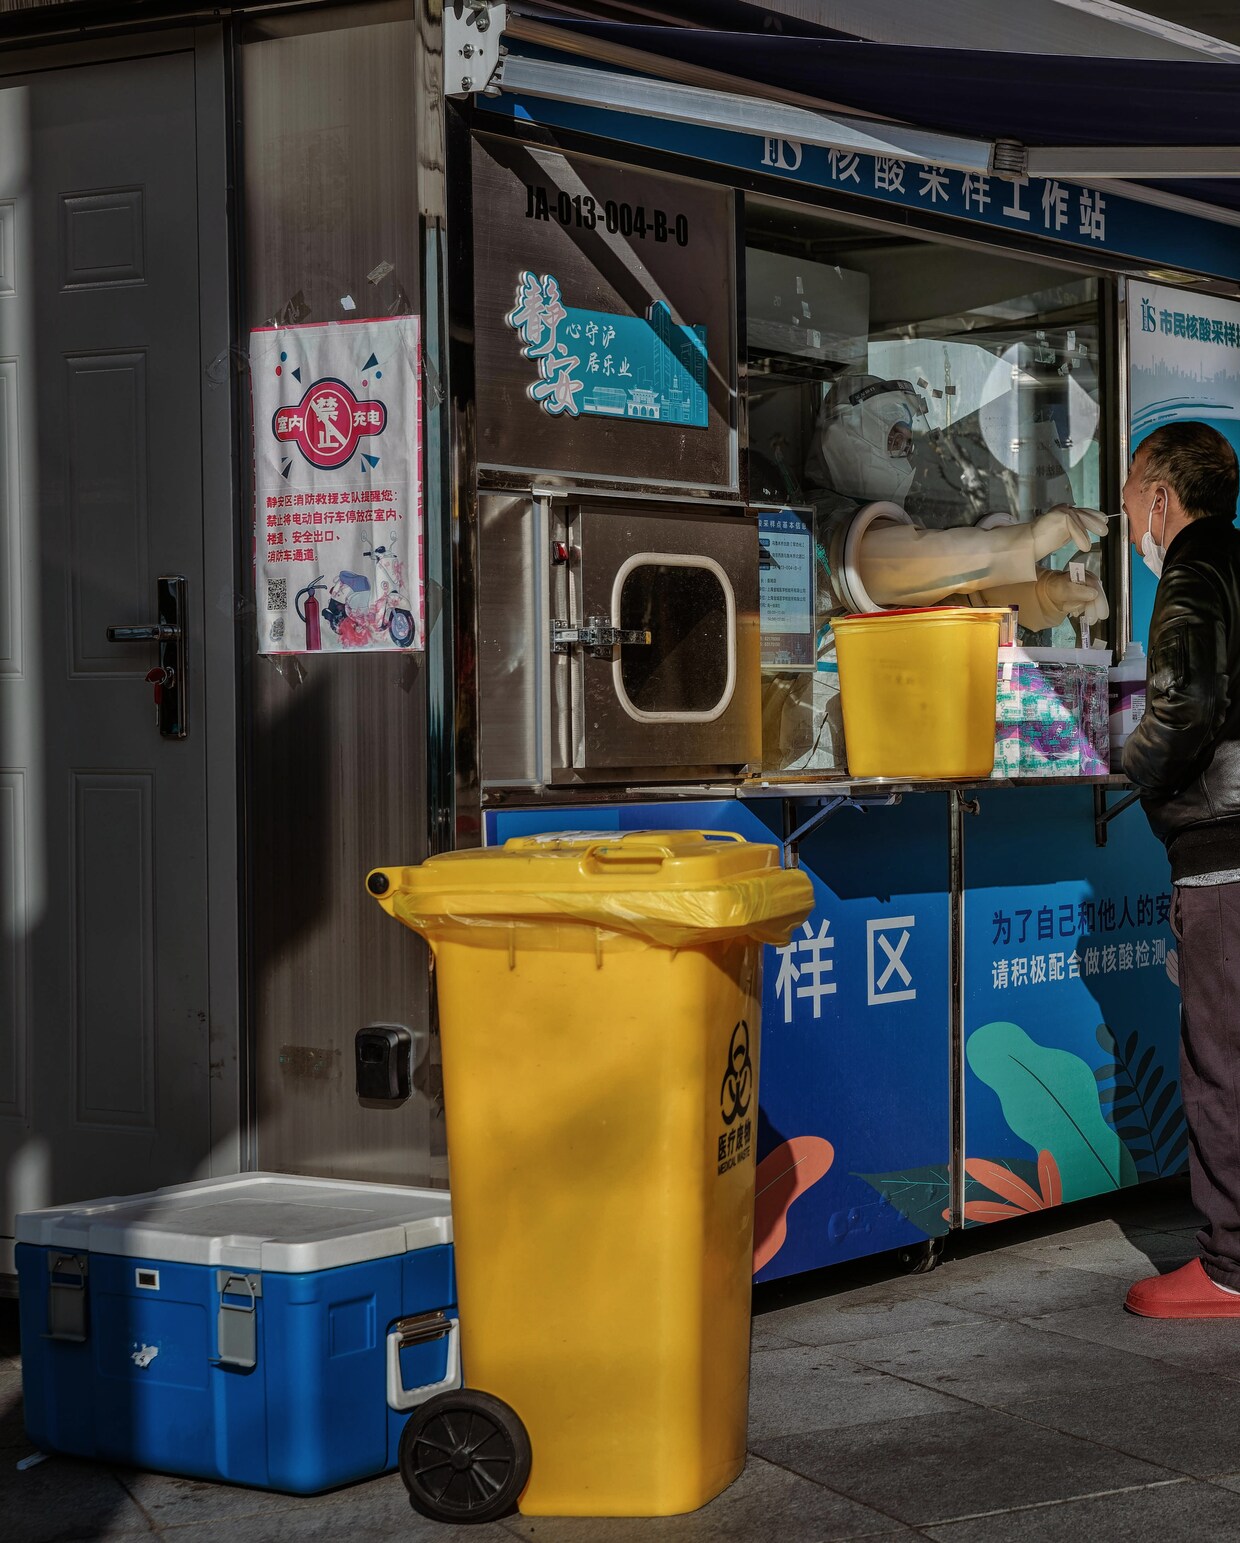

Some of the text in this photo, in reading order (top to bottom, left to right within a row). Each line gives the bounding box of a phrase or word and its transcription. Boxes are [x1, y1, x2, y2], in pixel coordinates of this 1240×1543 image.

[525, 184, 689, 248] JA-013-004-B-0
[827, 149, 1106, 242] 核酸采样工作站
[277, 414, 304, 434] 室内
[314, 396, 340, 449] 禁止
[353, 409, 381, 427] 充电
[991, 892, 1172, 946] 为了自己和他人的安
[774, 914, 917, 1023] 样区
[991, 938, 1166, 991] 请积极配合做核酸检测
[718, 1119, 752, 1162] 医疗废物
